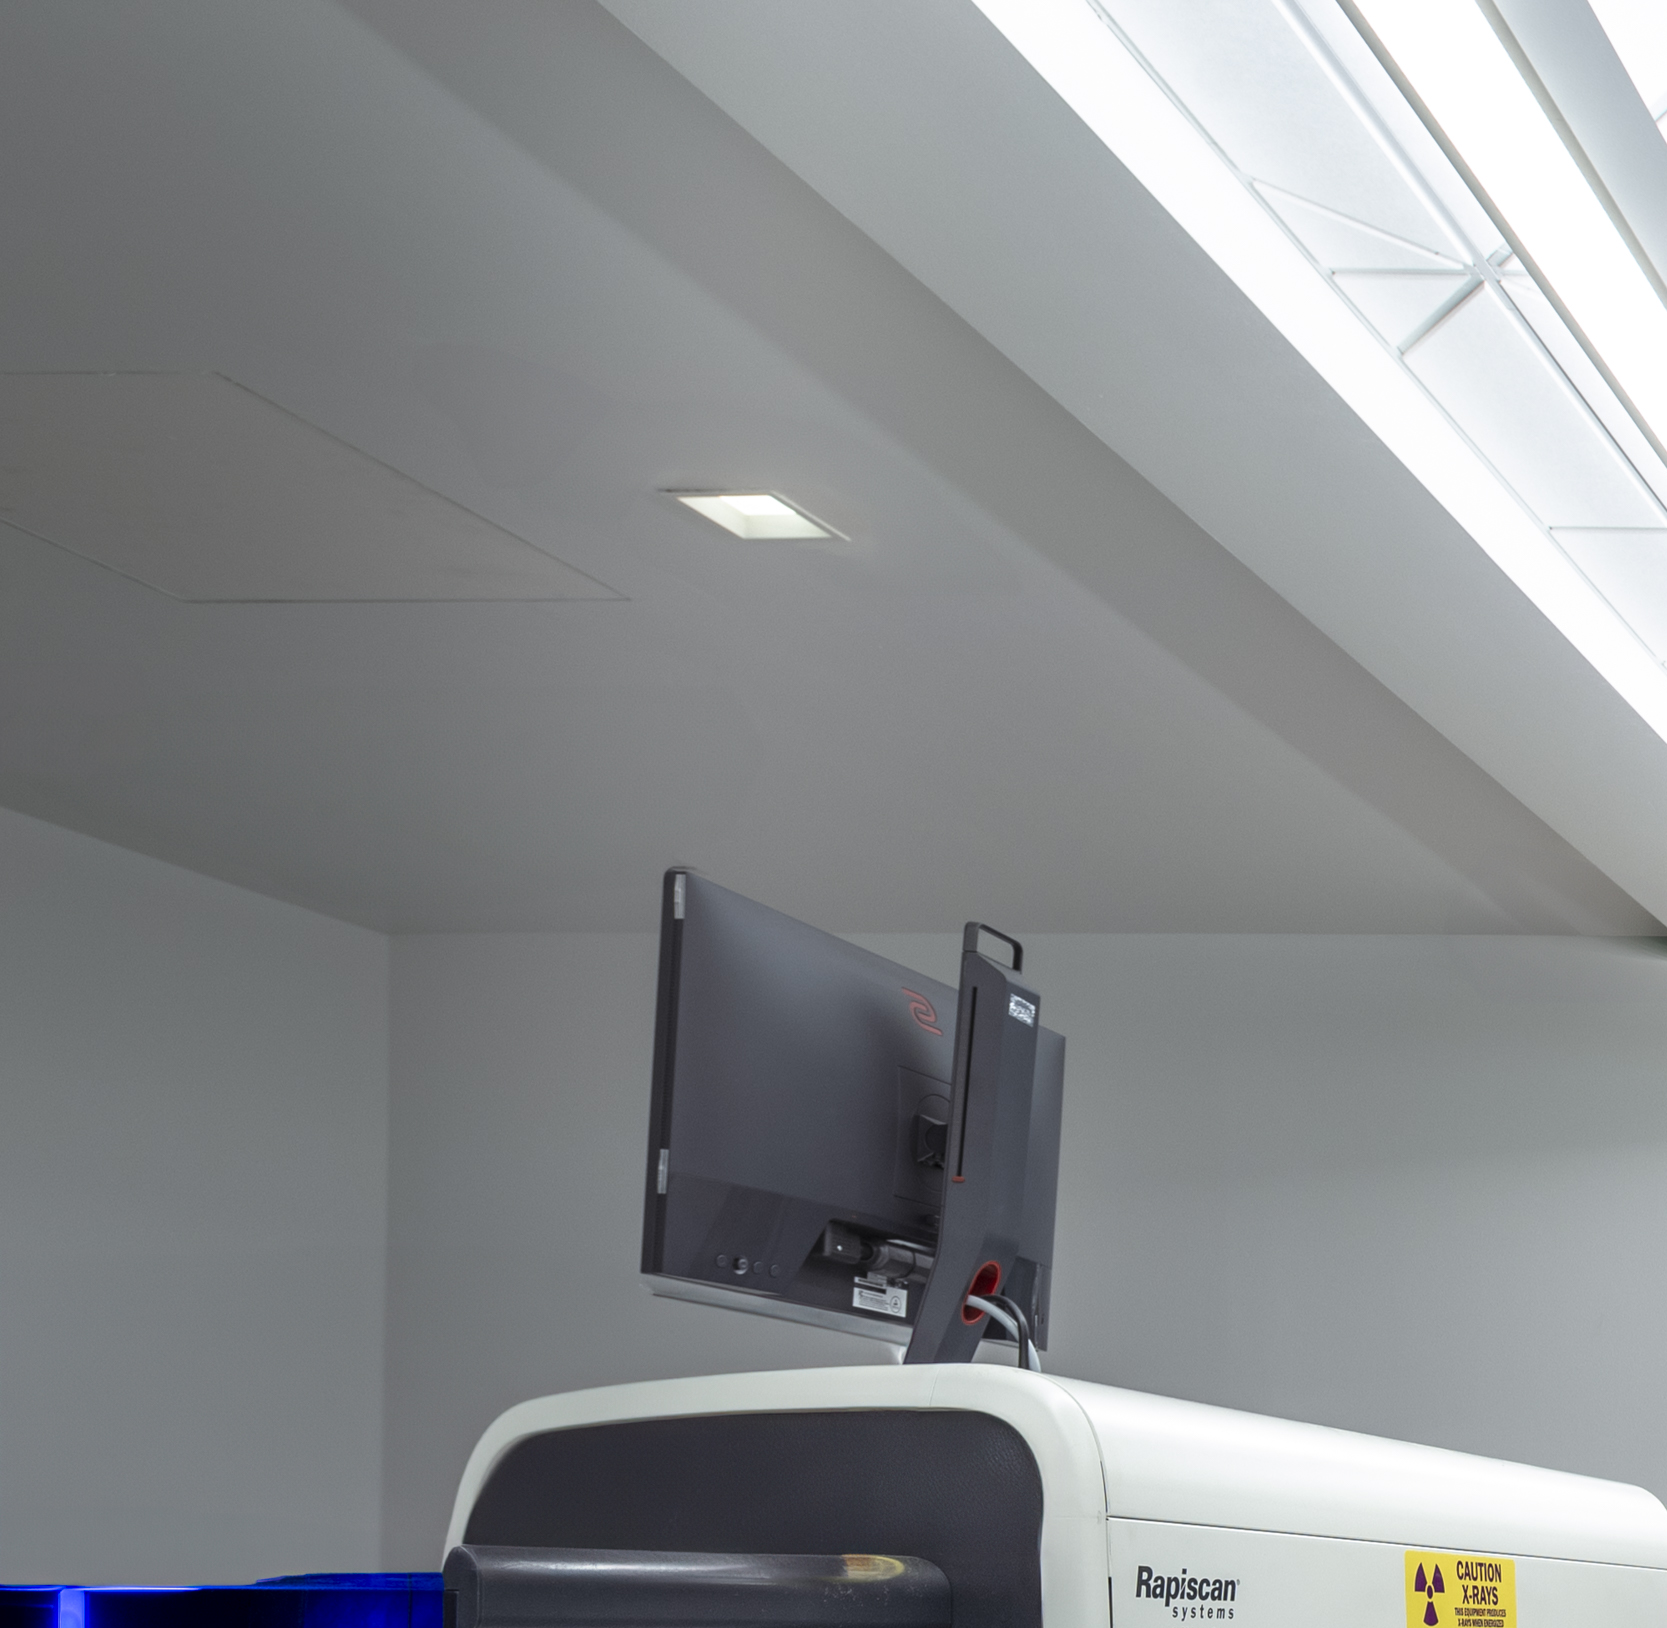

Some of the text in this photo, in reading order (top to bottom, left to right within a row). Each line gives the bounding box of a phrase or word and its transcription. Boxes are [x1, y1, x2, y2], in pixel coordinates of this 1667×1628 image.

[1456, 1560, 1502, 1583] CAUTION
[1135, 1565, 1236, 1607] Rapiscan
[1462, 1584, 1498, 1606] X-RAYS
[1172, 1604, 1234, 1622] systems
[1455, 1607, 1463, 1616] THIS
